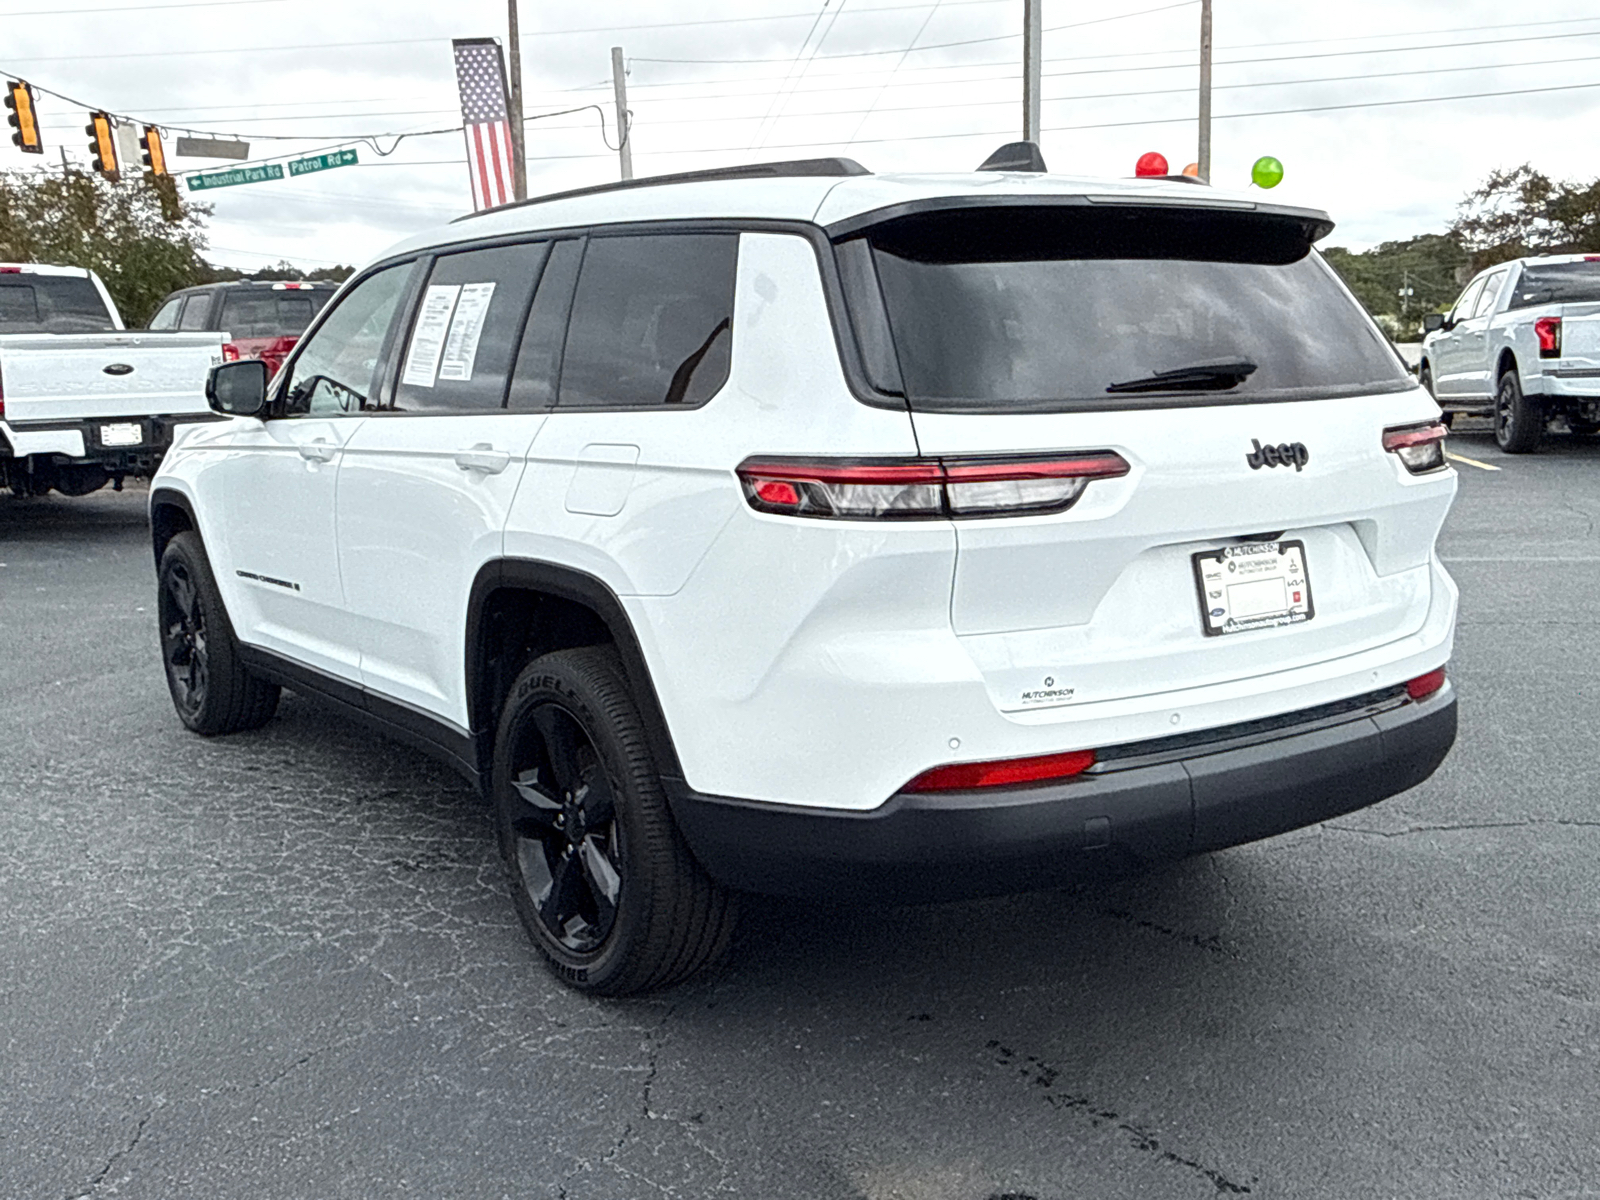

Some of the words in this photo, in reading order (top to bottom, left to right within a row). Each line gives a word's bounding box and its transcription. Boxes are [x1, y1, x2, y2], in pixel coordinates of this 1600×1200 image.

[291, 158, 322, 173] Patrol
[327, 155, 341, 167] Rd
[203, 171, 244, 187] Industrial
[245, 168, 265, 181] Park
[267, 165, 281, 178] Rd
[1245, 438, 1309, 472] Jeep
[1022, 688, 1074, 699] HUTCHINSON
